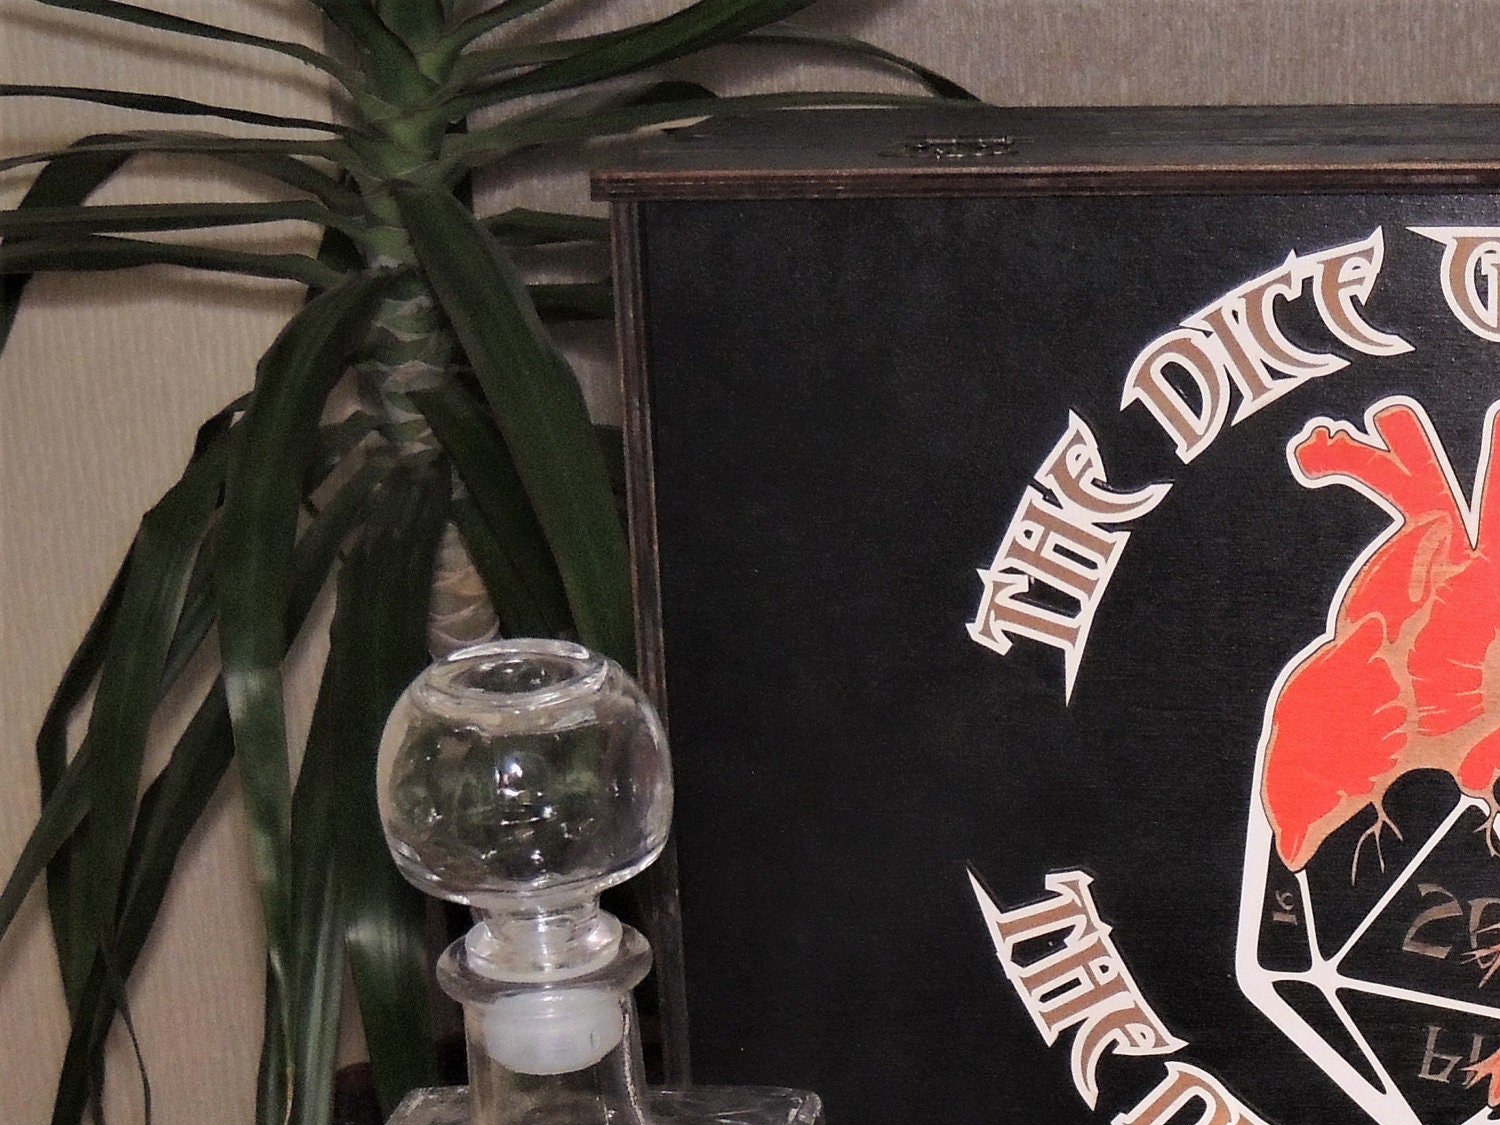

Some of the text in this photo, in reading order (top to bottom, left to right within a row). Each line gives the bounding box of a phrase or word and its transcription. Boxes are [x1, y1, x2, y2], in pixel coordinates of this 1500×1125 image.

[967, 409, 1173, 706] THE
[1120, 225, 1416, 463] DICE
[966, 862, 1189, 1111] THE
